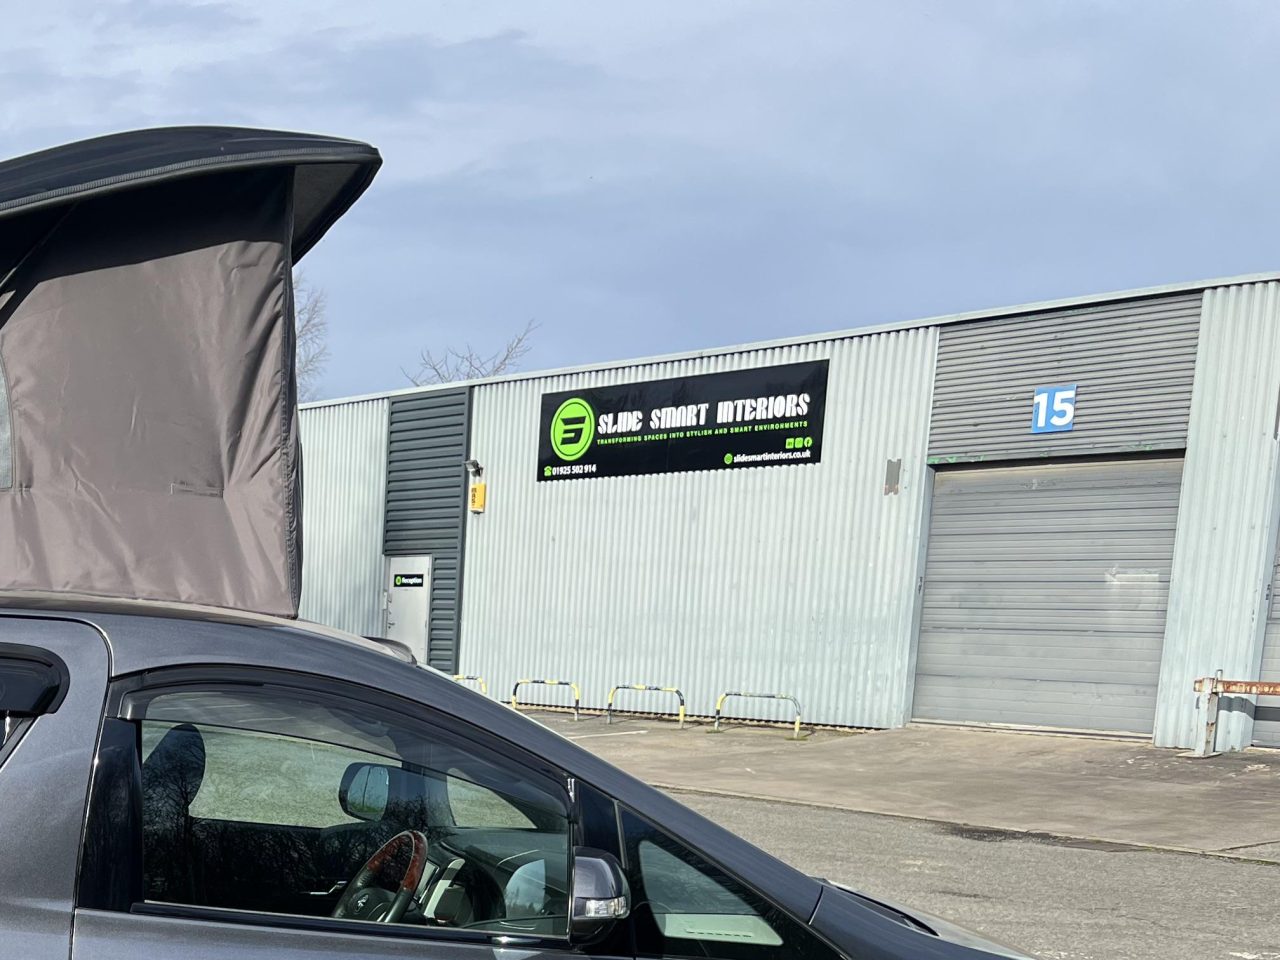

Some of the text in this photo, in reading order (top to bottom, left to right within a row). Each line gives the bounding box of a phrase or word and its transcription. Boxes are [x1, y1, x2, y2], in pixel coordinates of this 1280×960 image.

[597, 393, 811, 434] SLIDE SMART INTERIORS
[1033, 390, 1075, 427] 15
[597, 420, 808, 446] TRANSFORMING SPACES INTO STYLISH AND SMART ENVIRONMENTS
[733, 449, 811, 463] slidesmartinteriors.co.uk
[552, 464, 597, 476] 01925 502 914
